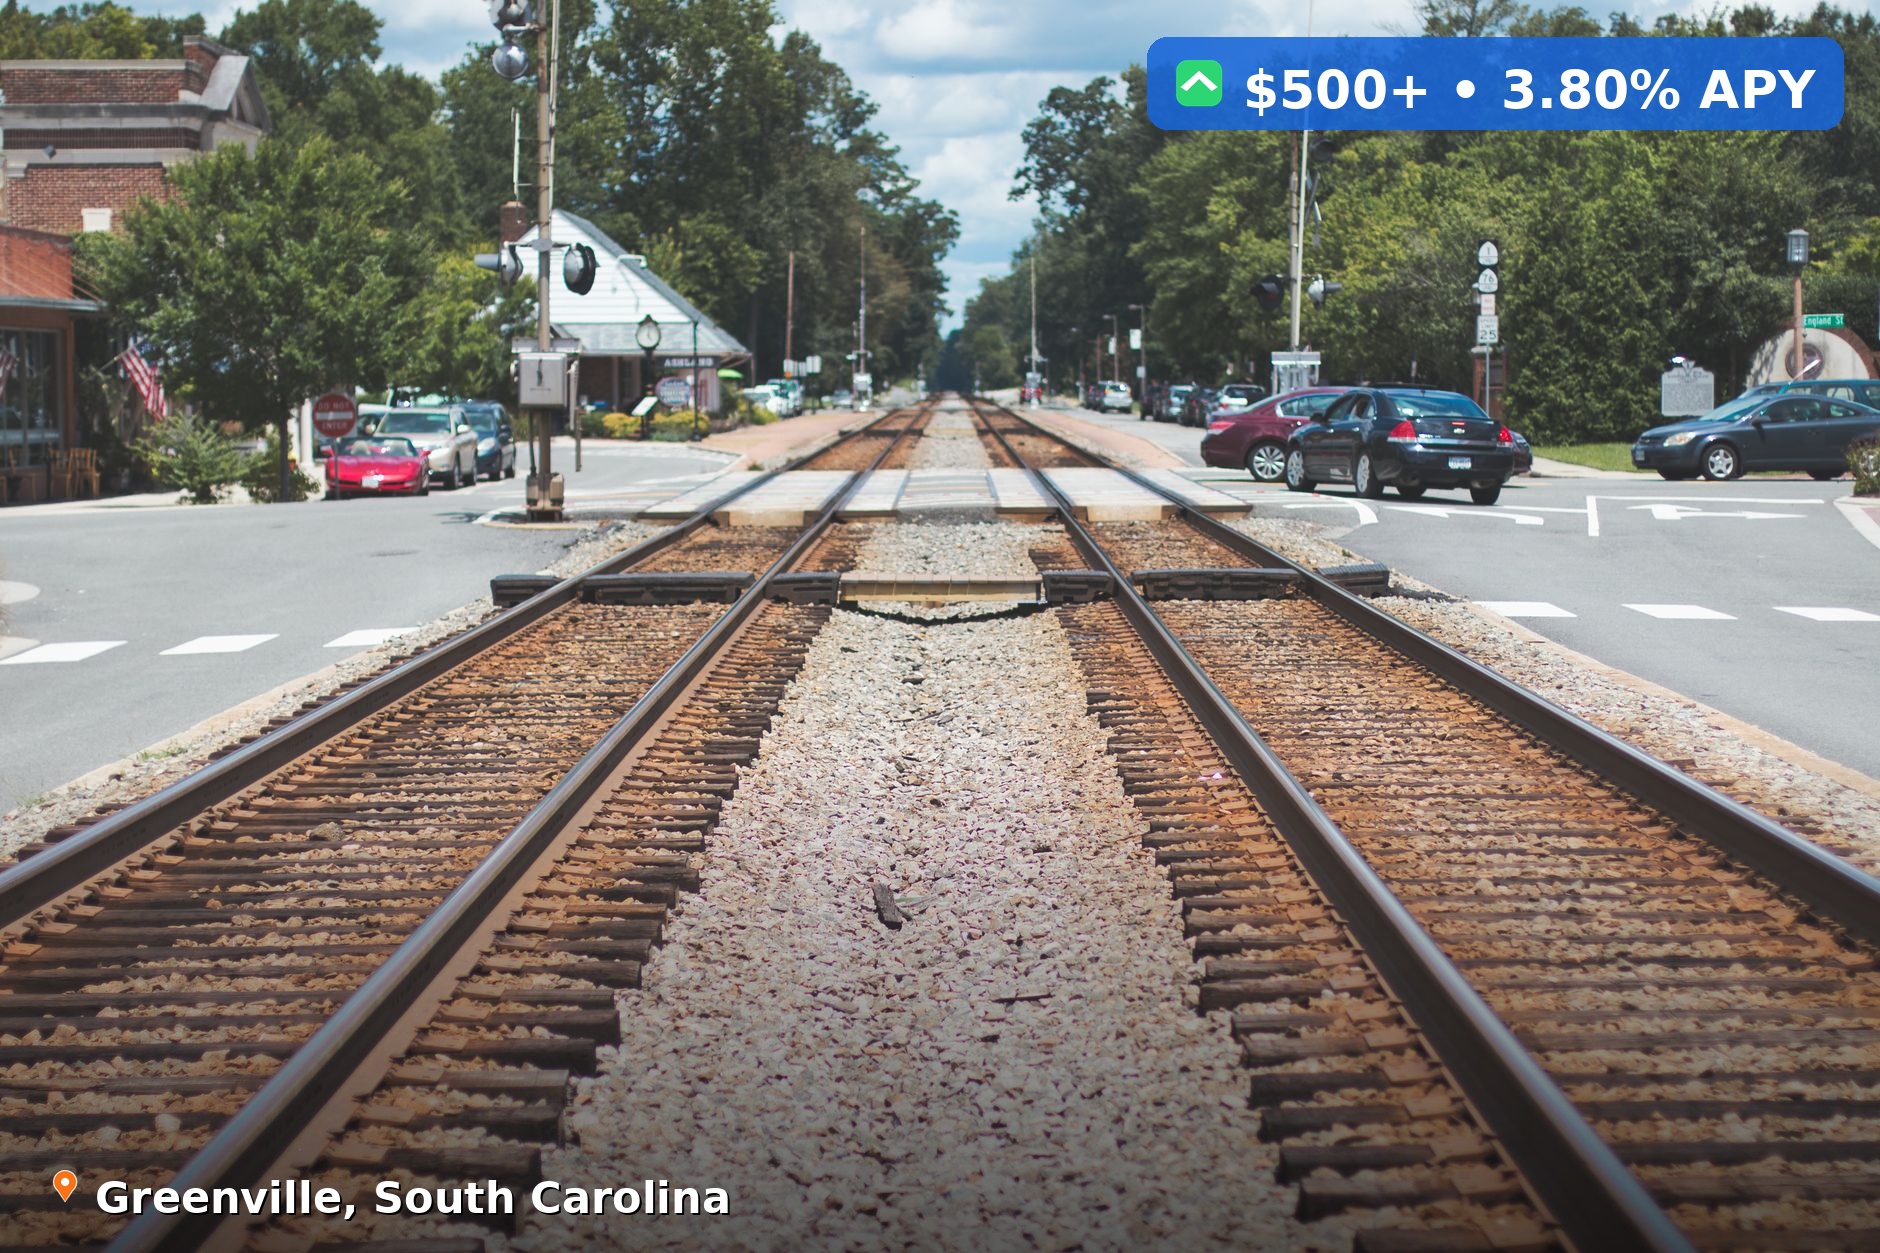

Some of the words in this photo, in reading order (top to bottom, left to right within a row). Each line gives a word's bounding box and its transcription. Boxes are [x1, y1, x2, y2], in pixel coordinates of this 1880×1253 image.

[1483, 274, 1495, 283] 76
[1803, 316, 1831, 327] England
[1480, 330, 1497, 340] 25
[319, 401, 329, 409] DO
[333, 401, 350, 409] NOT
[322, 421, 347, 429] ENTER
